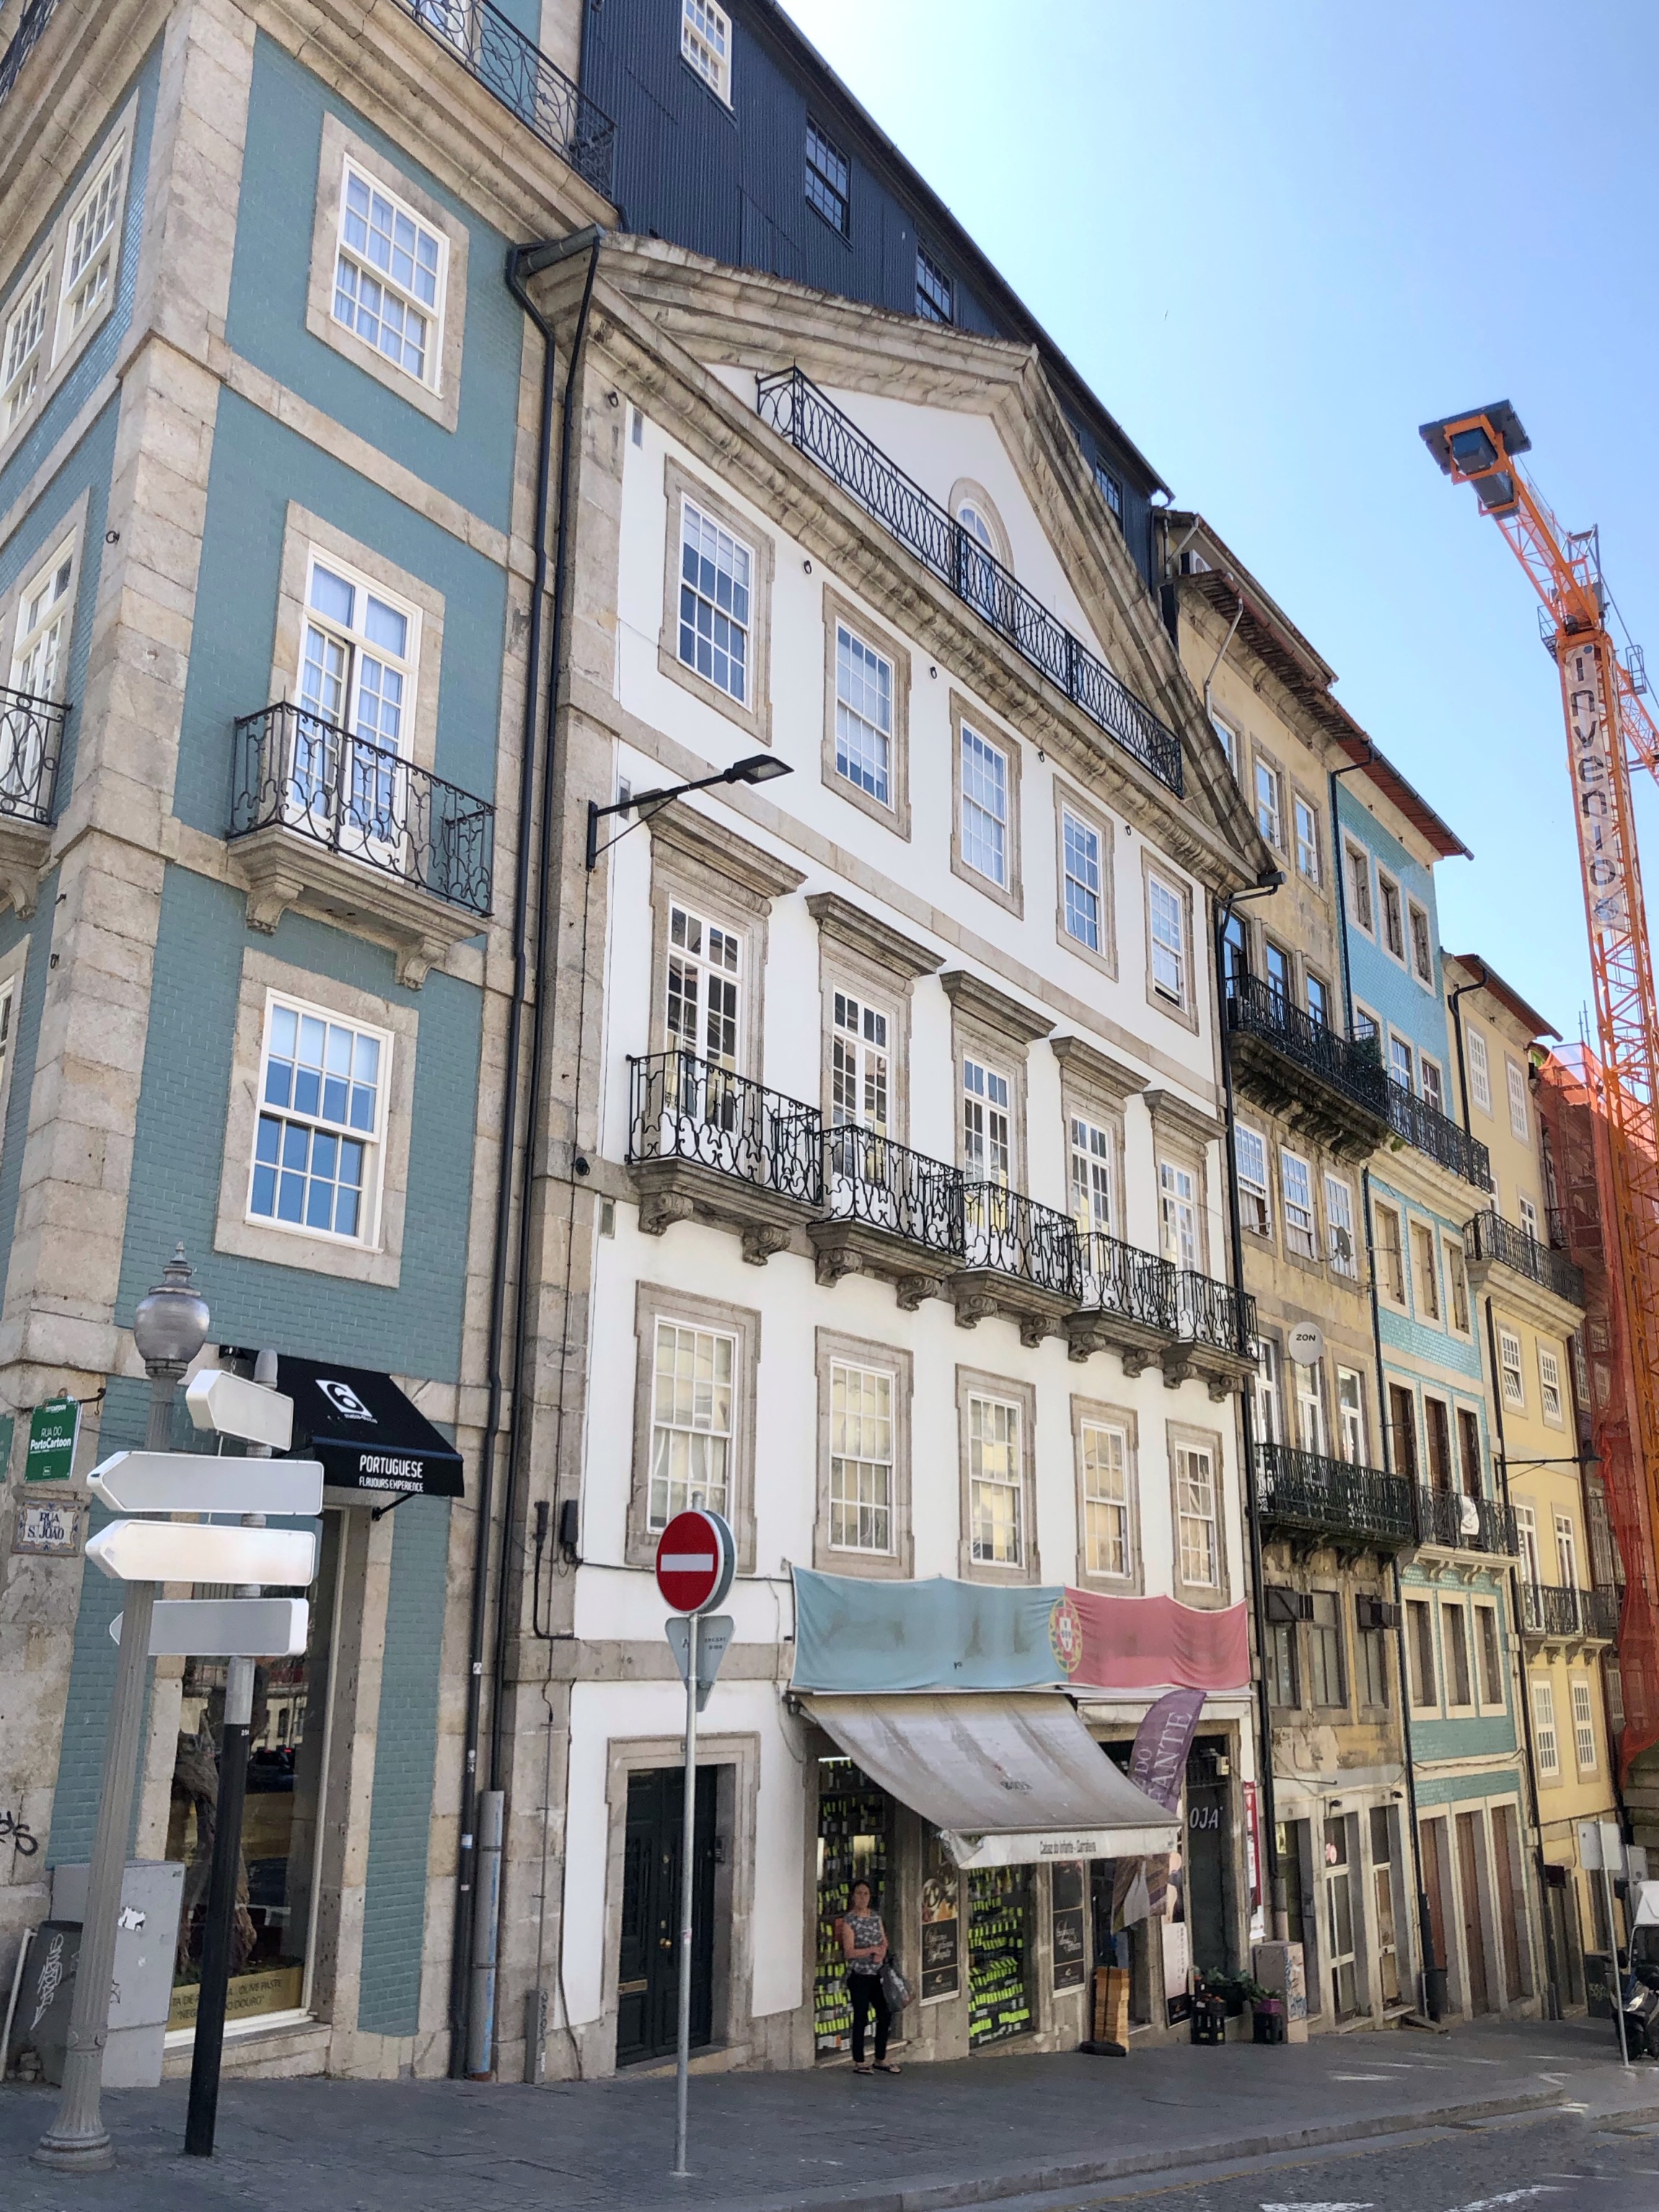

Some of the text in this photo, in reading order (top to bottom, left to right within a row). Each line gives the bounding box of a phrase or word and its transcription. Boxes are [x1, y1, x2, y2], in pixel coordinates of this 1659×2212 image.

[1295, 1333, 1316, 1342] ZON
[41, 1426, 63, 1438] RUA DO
[30, 1437, 71, 1451] PortoCartoon
[359, 1454, 424, 1478] PORTUGUESE
[359, 1475, 424, 1493] FLAVOURS EXPERIENCE
[40, 1512, 60, 1522] RUA
[1135, 1748, 1152, 1774] DO
[1148, 1711, 1192, 1804] FANTE
[1189, 1807, 1218, 1829] OJA
